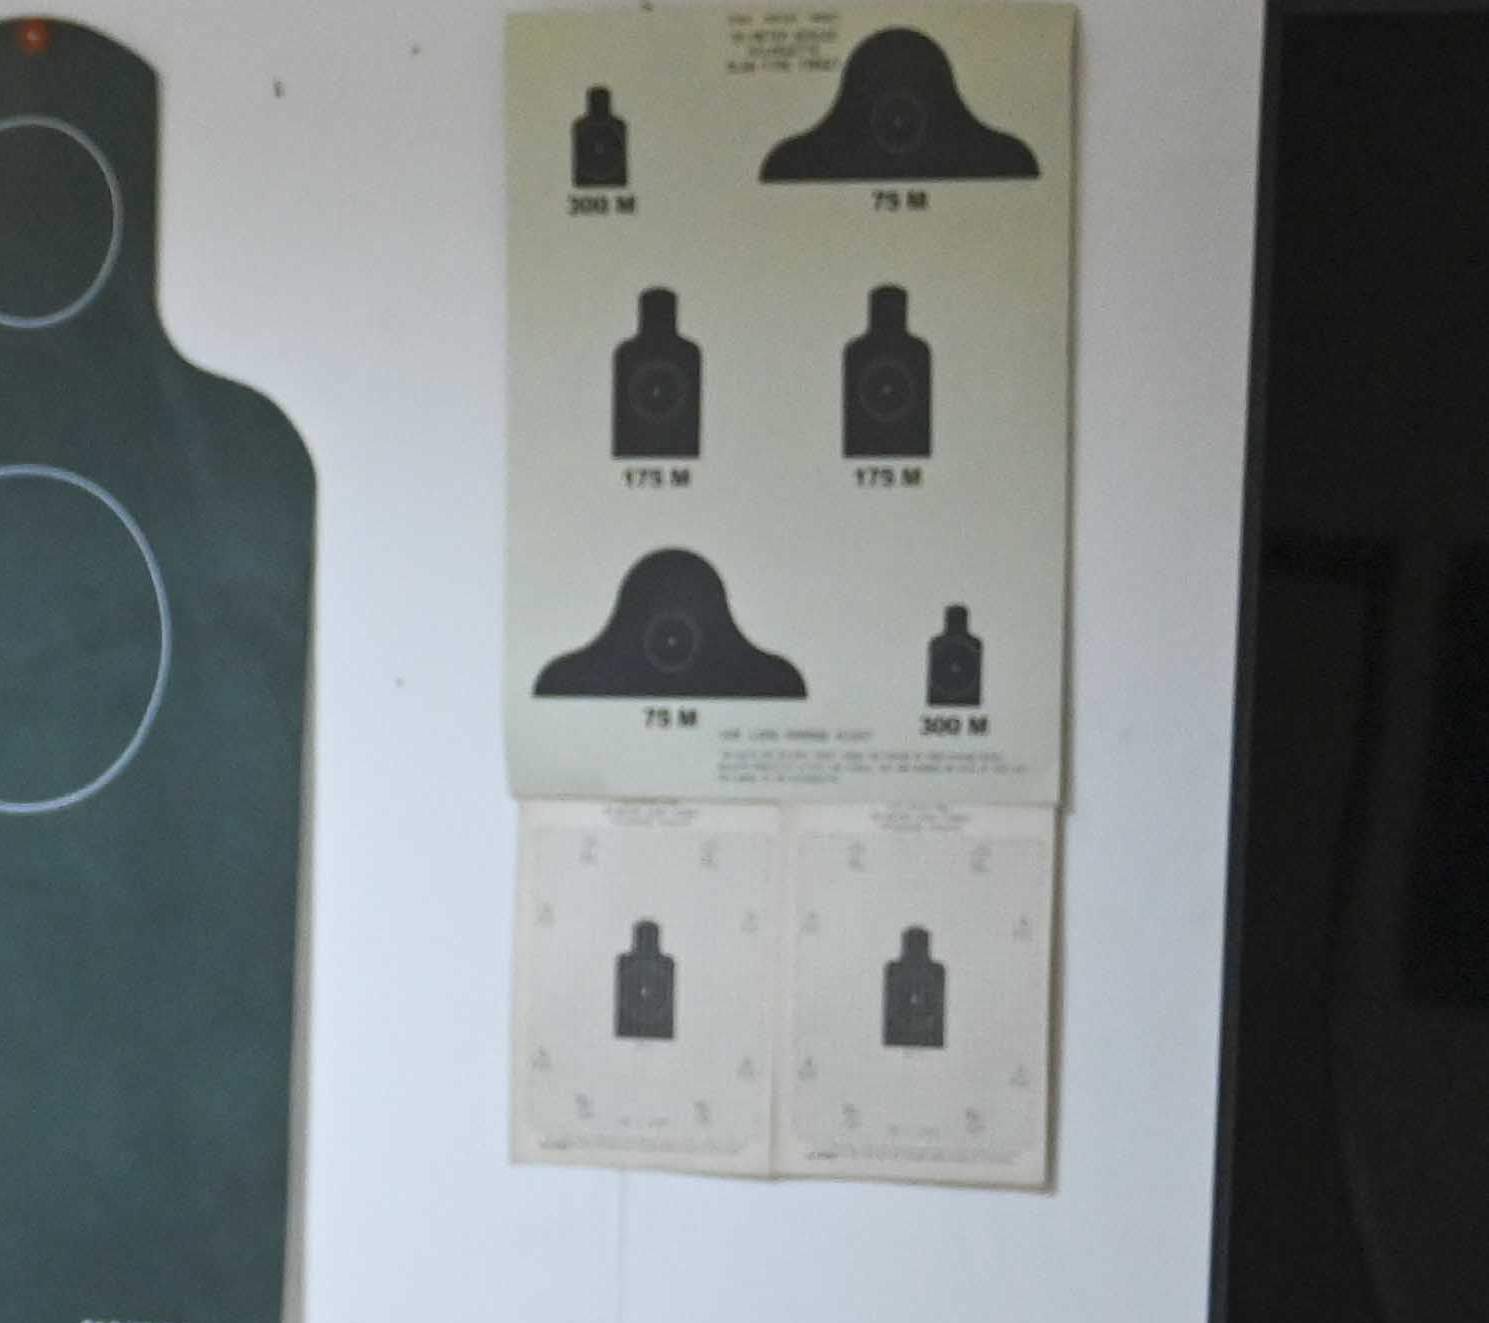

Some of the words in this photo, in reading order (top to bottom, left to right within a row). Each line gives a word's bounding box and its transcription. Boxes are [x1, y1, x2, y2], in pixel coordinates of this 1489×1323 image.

[568, 194, 610, 217] 300
[615, 194, 637, 216] M
[872, 190, 900, 212] 75
[907, 190, 927, 211] M
[623, 467, 662, 488] 175
[670, 467, 691, 488] M
[855, 467, 895, 488] 175
[902, 467, 923, 488] M
[643, 707, 671, 728] 75
[678, 708, 698, 728] M
[919, 715, 961, 736] 300
[967, 715, 989, 736] M
